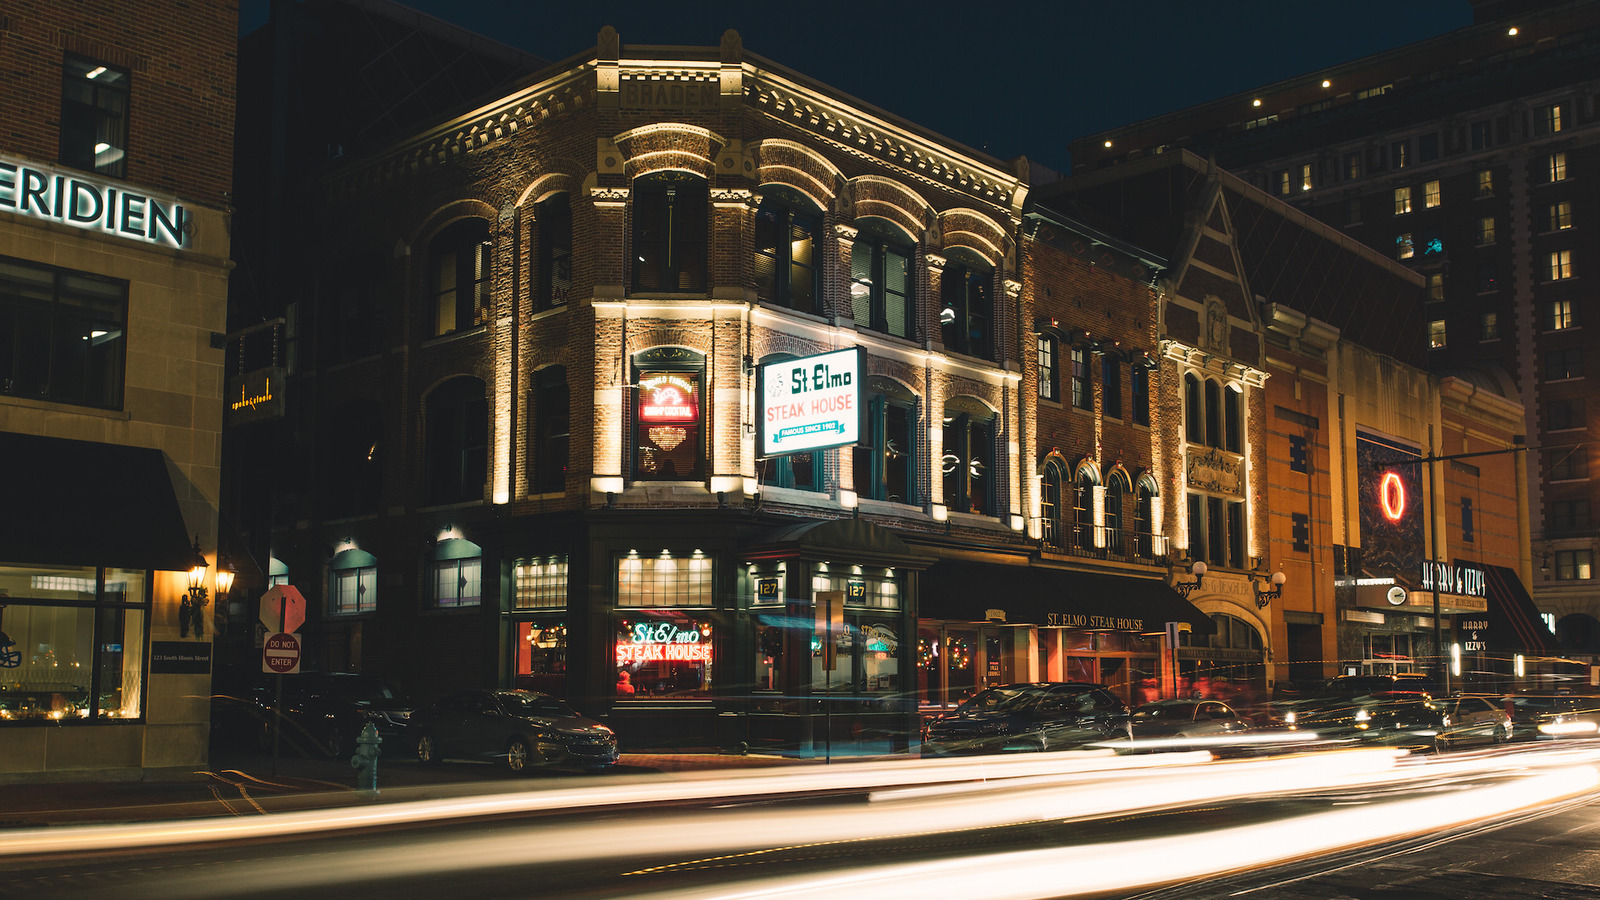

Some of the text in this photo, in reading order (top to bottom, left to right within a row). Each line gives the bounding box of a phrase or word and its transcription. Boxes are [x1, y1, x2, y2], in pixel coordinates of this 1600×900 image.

[669, 376, 692, 393] FAMOUS
[767, 394, 852, 422] STEAK HOUSE
[781, 422, 836, 437] FAMOUS SINCE 1902
[1456, 567, 1463, 594] &
[760, 583, 777, 595] 127
[849, 586, 865, 597] 127
[1047, 613, 1144, 631] ST. ELMO STEAK HOUSE
[1462, 621, 1488, 630] HARRY
[1471, 630, 1478, 640] &
[282, 641, 294, 649] NOT
[1465, 641, 1486, 651] IZZY'S
[616, 645, 711, 661] STEAK HOUSE
[271, 658, 292, 666] ENTER
